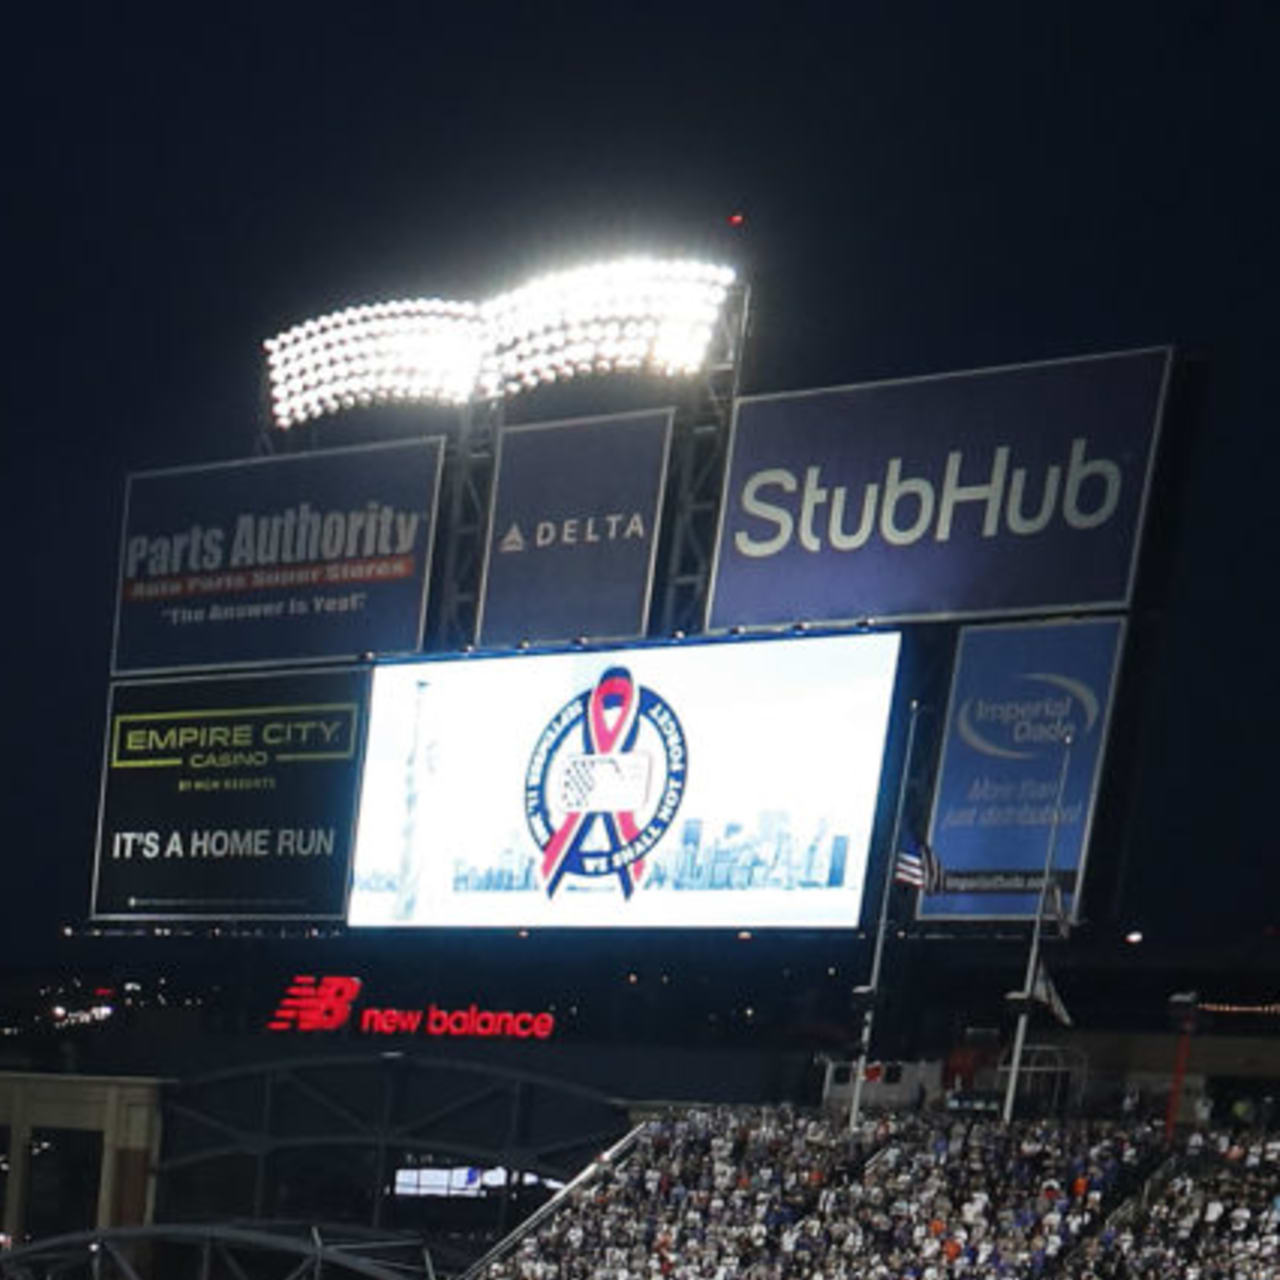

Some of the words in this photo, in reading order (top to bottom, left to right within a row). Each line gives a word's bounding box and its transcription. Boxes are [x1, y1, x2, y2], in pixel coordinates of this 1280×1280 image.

[734, 438, 1123, 558] StubHub
[125, 524, 226, 578] Parts
[231, 502, 420, 568] Authority
[535, 512, 647, 547] DELTA
[126, 724, 254, 751] EMPIRE
[189, 751, 269, 769] CASINO
[112, 830, 160, 859] IT'S
[164, 831, 184, 859] A
[189, 828, 270, 857] HOME
[277, 827, 336, 856] RUN
[360, 1007, 423, 1034] new
[426, 1004, 555, 1038] balance
